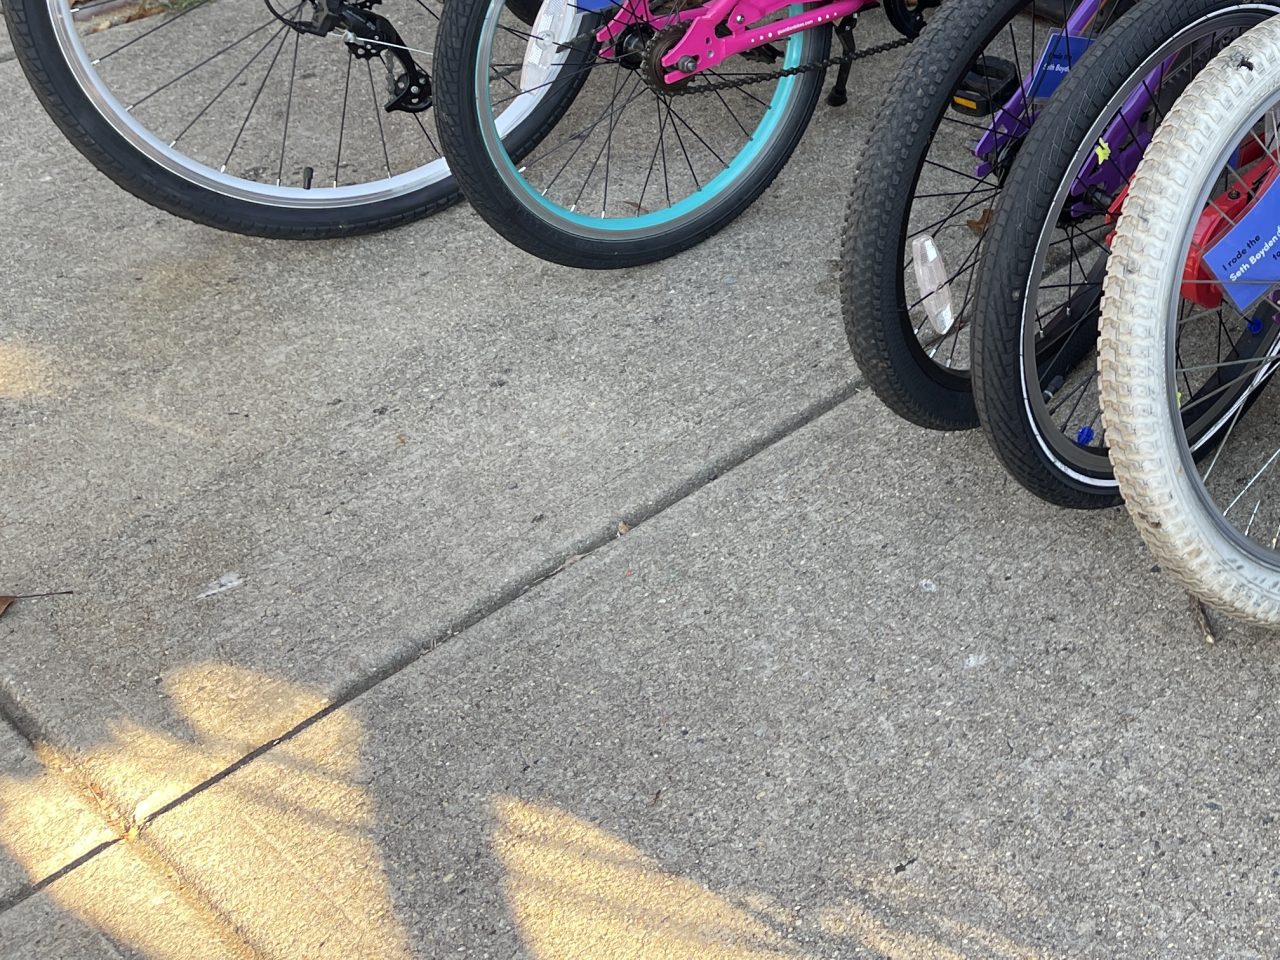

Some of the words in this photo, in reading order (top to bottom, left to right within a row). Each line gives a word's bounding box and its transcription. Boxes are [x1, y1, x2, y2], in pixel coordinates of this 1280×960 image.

[1228, 248, 1247, 267] rode
[1247, 234, 1261, 250] the
[1229, 263, 1250, 282] Seth
[1249, 235, 1279, 266] Boyden
